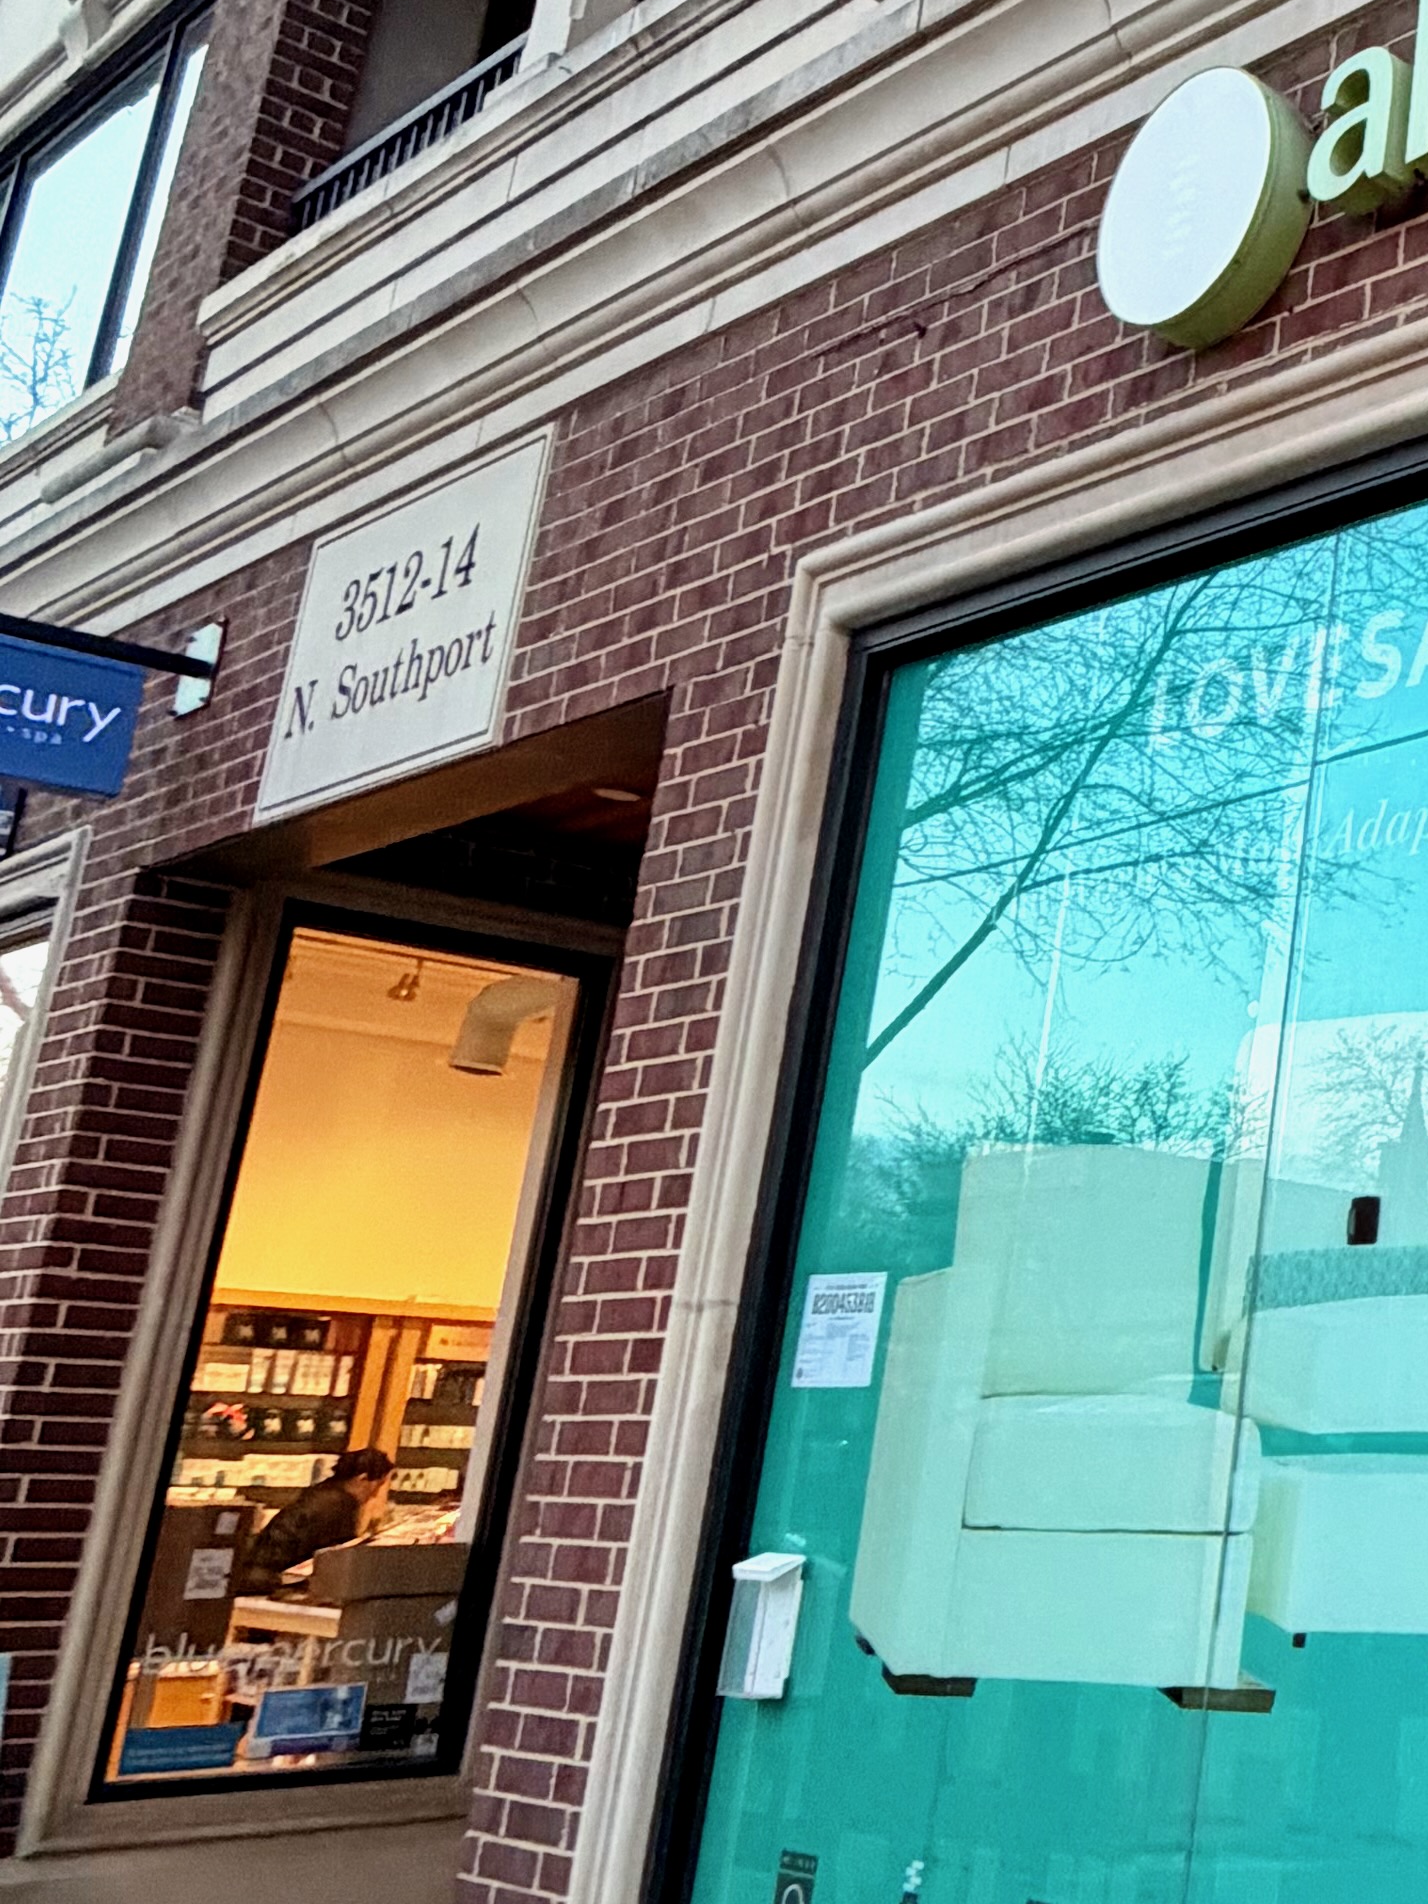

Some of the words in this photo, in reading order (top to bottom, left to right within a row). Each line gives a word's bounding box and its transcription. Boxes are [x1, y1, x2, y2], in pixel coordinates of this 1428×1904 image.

[335, 522, 480, 641] 3512-14
[284, 680, 319, 739] N.
[331, 610, 496, 720] Southport
[21, 727, 62, 745] spa
